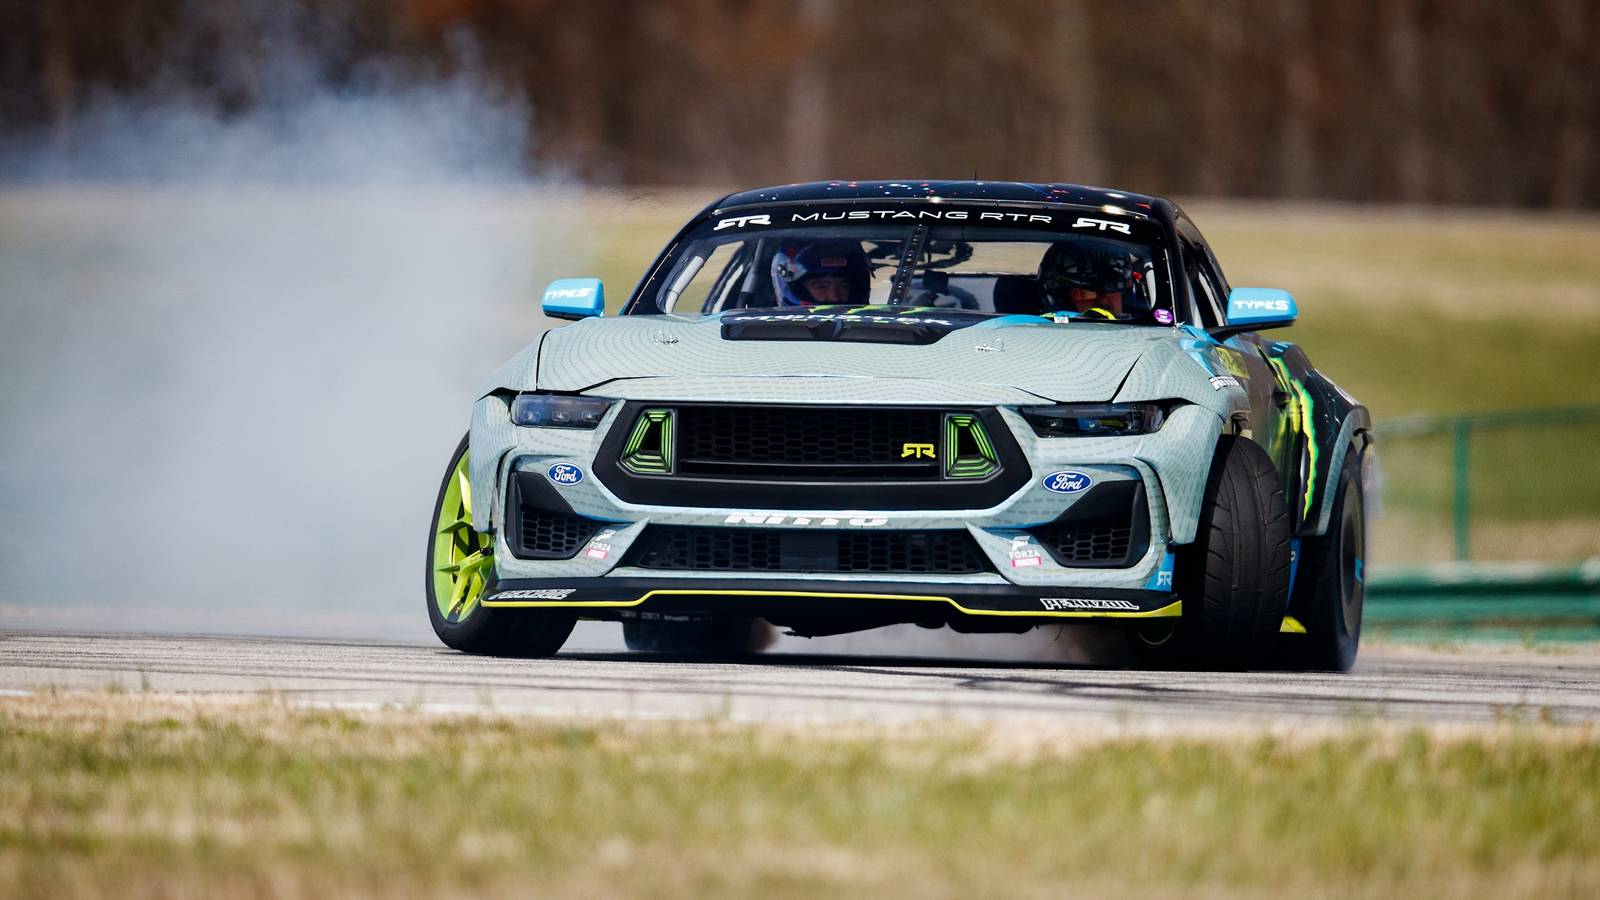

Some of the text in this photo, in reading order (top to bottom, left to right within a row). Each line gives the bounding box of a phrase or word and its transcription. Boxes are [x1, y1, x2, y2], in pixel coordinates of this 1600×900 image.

[713, 214, 772, 231] RTR
[791, 210, 1053, 224] MUSTANG RTR
[1071, 217, 1132, 235] RTR
[900, 442, 937, 459] RTR
[554, 465, 577, 482] Ford
[1051, 473, 1084, 490] Ford
[1009, 550, 1040, 559] FORZA
